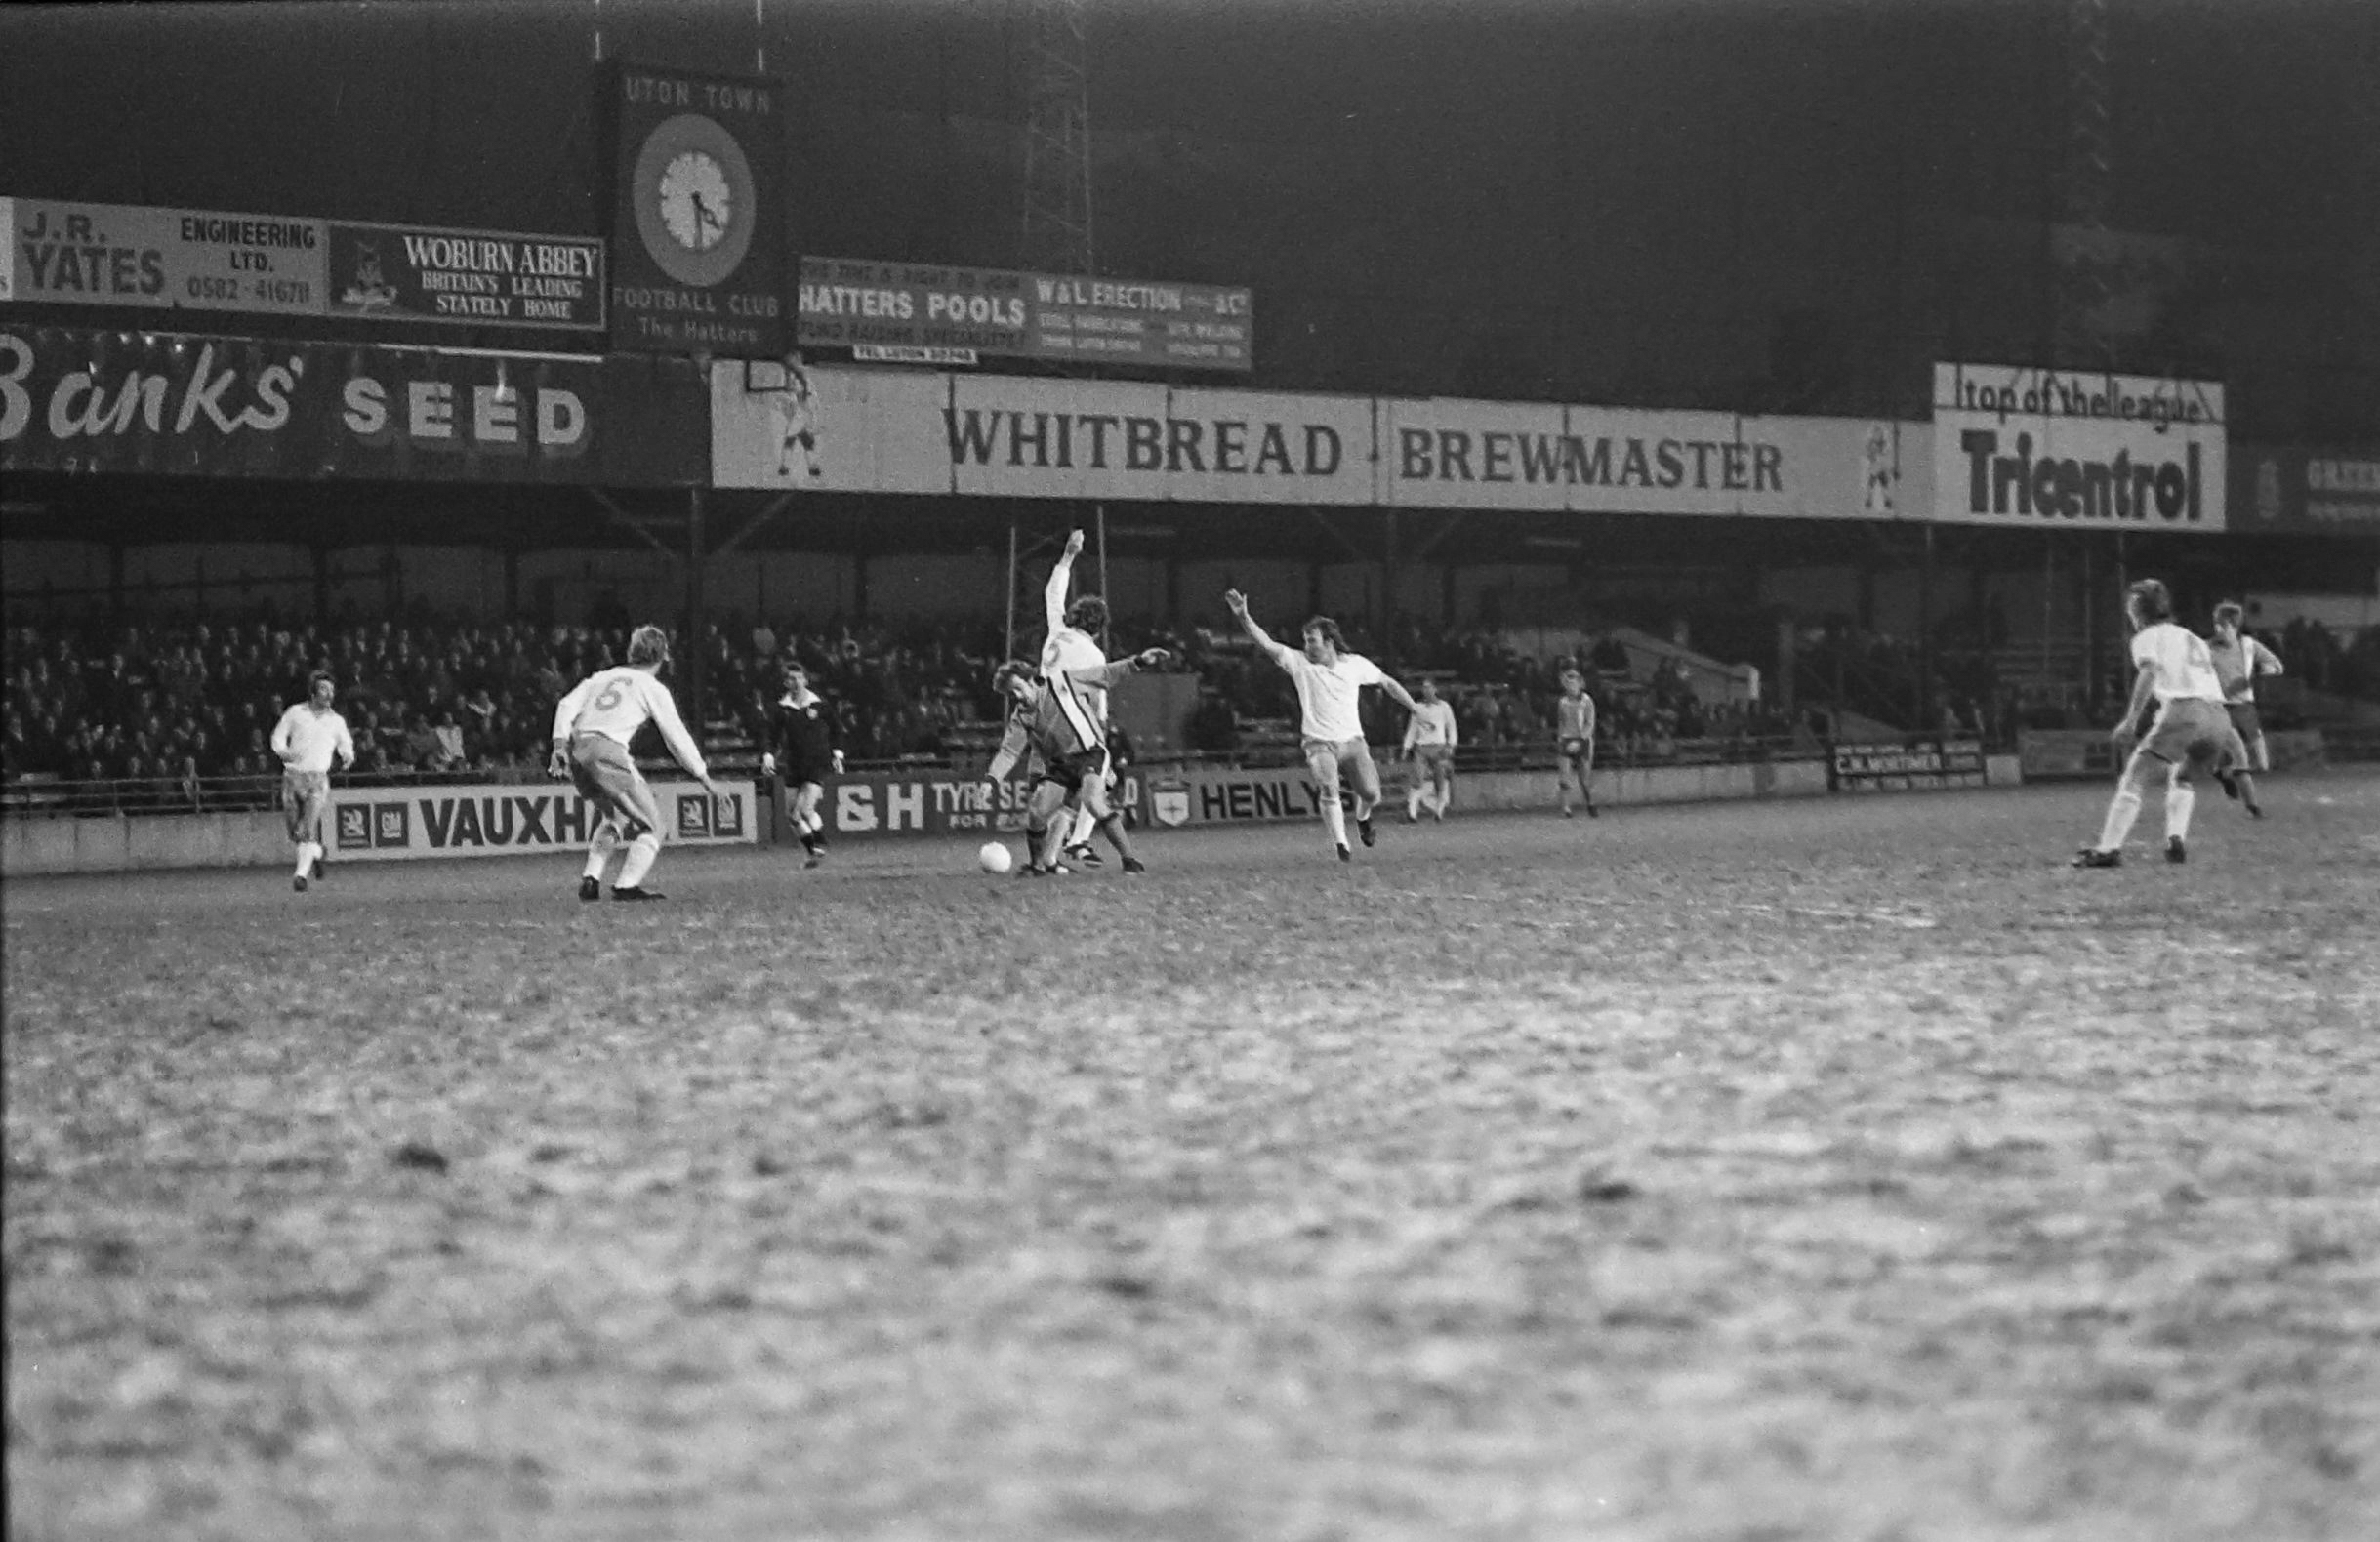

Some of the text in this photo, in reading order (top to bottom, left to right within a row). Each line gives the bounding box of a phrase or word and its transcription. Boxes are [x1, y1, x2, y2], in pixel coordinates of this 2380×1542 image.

[705, 84, 770, 114] TOWN
[22, 212, 106, 243] J.R.
[181, 217, 315, 249] ENGINEERING
[21, 244, 165, 296] YATES
[230, 251, 275, 273] LTD.
[403, 235, 598, 278] WOBURN ABBEY
[187, 275, 238, 300] 0582
[512, 276, 584, 299] LEADING
[613, 288, 779, 317] FOOTBALL CLUB
[1091, 282, 1182, 311] ERECTION
[436, 294, 572, 319] STATELY HOME
[799, 283, 914, 320] HATTERS
[927, 292, 1026, 329] POOLS
[639, 317, 759, 342] The Hatters
[342, 377, 585, 445] SEED
[1966, 380, 2017, 424] top
[2024, 375, 2054, 414] of
[942, 407, 1785, 493] WHITBREAD BREWMASTER
[1960, 428, 2201, 521] Tricentrol
[595, 676, 634, 711] 6
